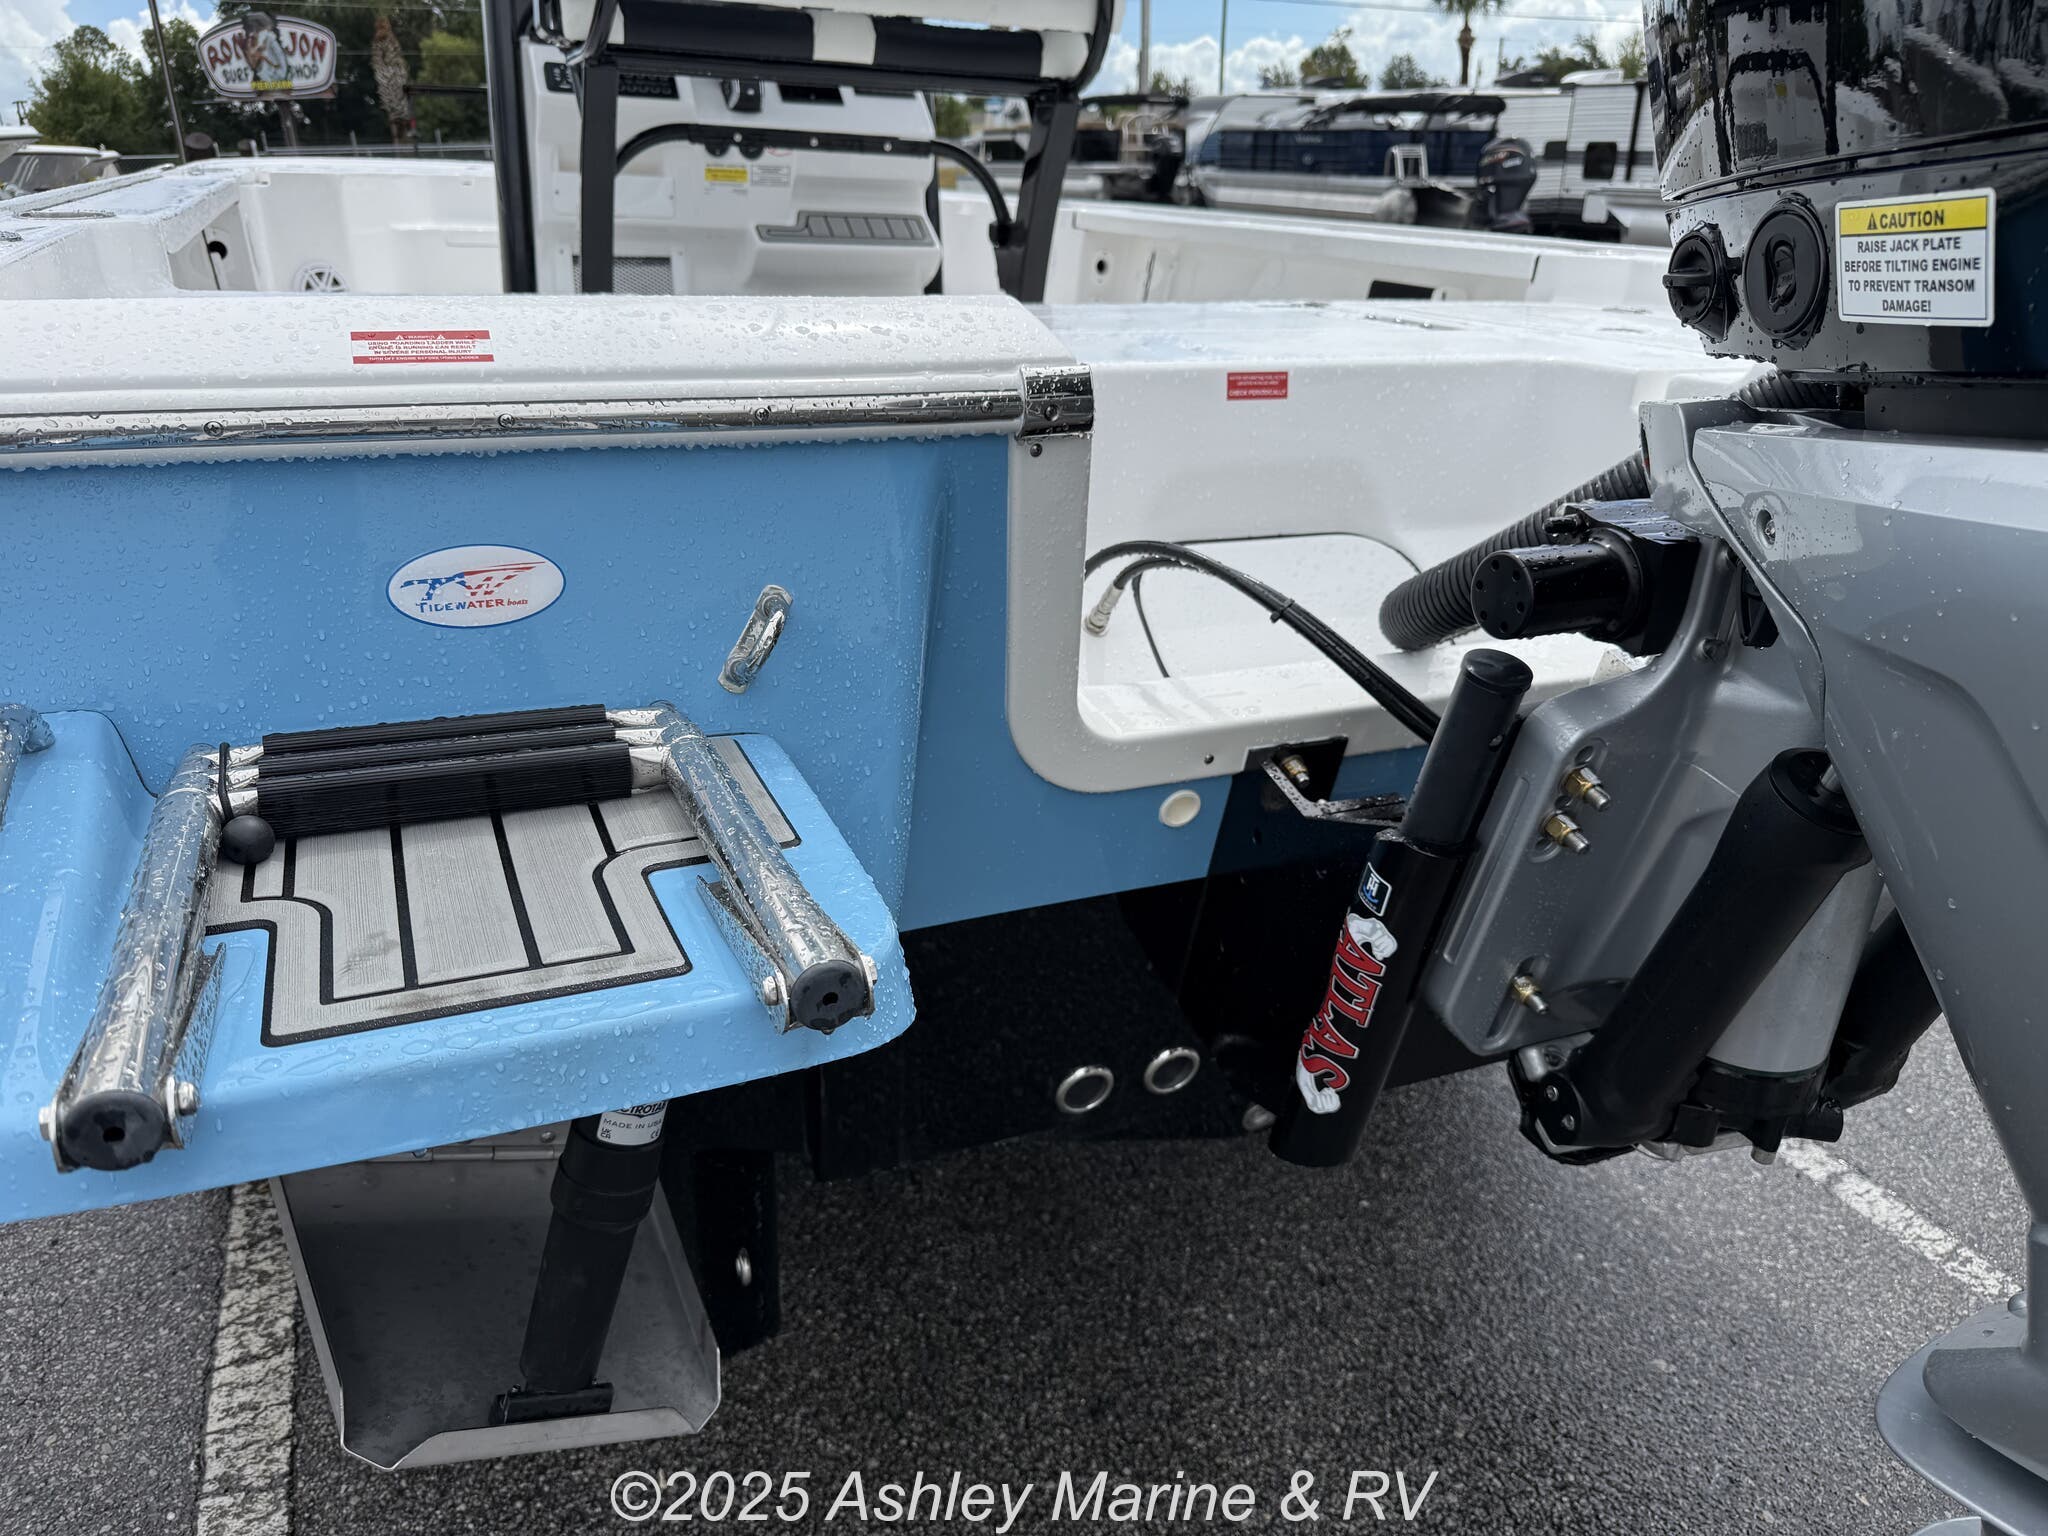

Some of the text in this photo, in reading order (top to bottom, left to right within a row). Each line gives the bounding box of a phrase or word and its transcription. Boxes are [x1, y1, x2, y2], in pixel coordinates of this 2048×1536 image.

[207, 31, 327, 71] RON JON
[222, 64, 319, 84] SURF SHOP
[1880, 209, 1945, 229] CAUTION
[1857, 236, 1961, 253] RAISE JACK PLATE
[1844, 257, 1981, 273] BEFORE TILTING ENGINE
[1848, 279, 1975, 292] TO PREVENT TRANSOM
[1882, 300, 1931, 312] DAMAGE!
[416, 598, 505, 613] TIDEWATER
[1300, 913, 1386, 1093] ATLAS
[603, 1118, 632, 1129] MADE
